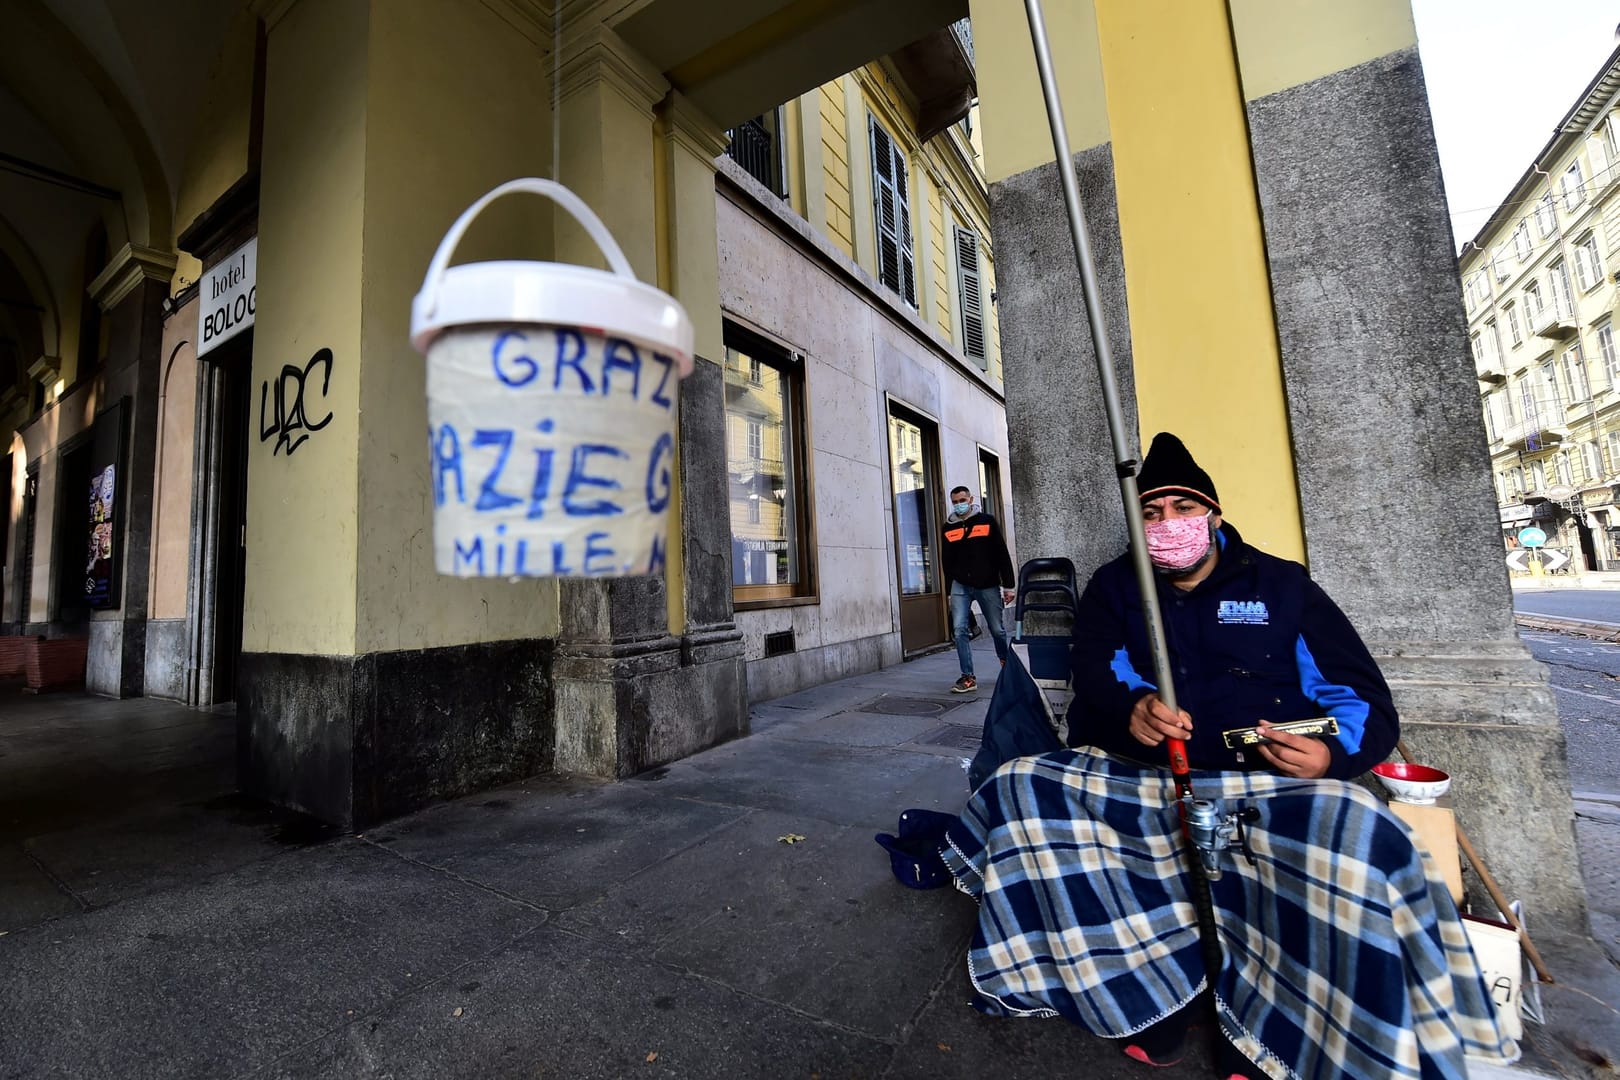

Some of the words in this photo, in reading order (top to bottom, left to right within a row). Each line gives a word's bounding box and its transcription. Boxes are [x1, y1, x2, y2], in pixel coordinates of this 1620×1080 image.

[211, 254, 246, 301] hotel
[203, 285, 257, 343] BOLOG
[491, 327, 676, 410] GRAZ
